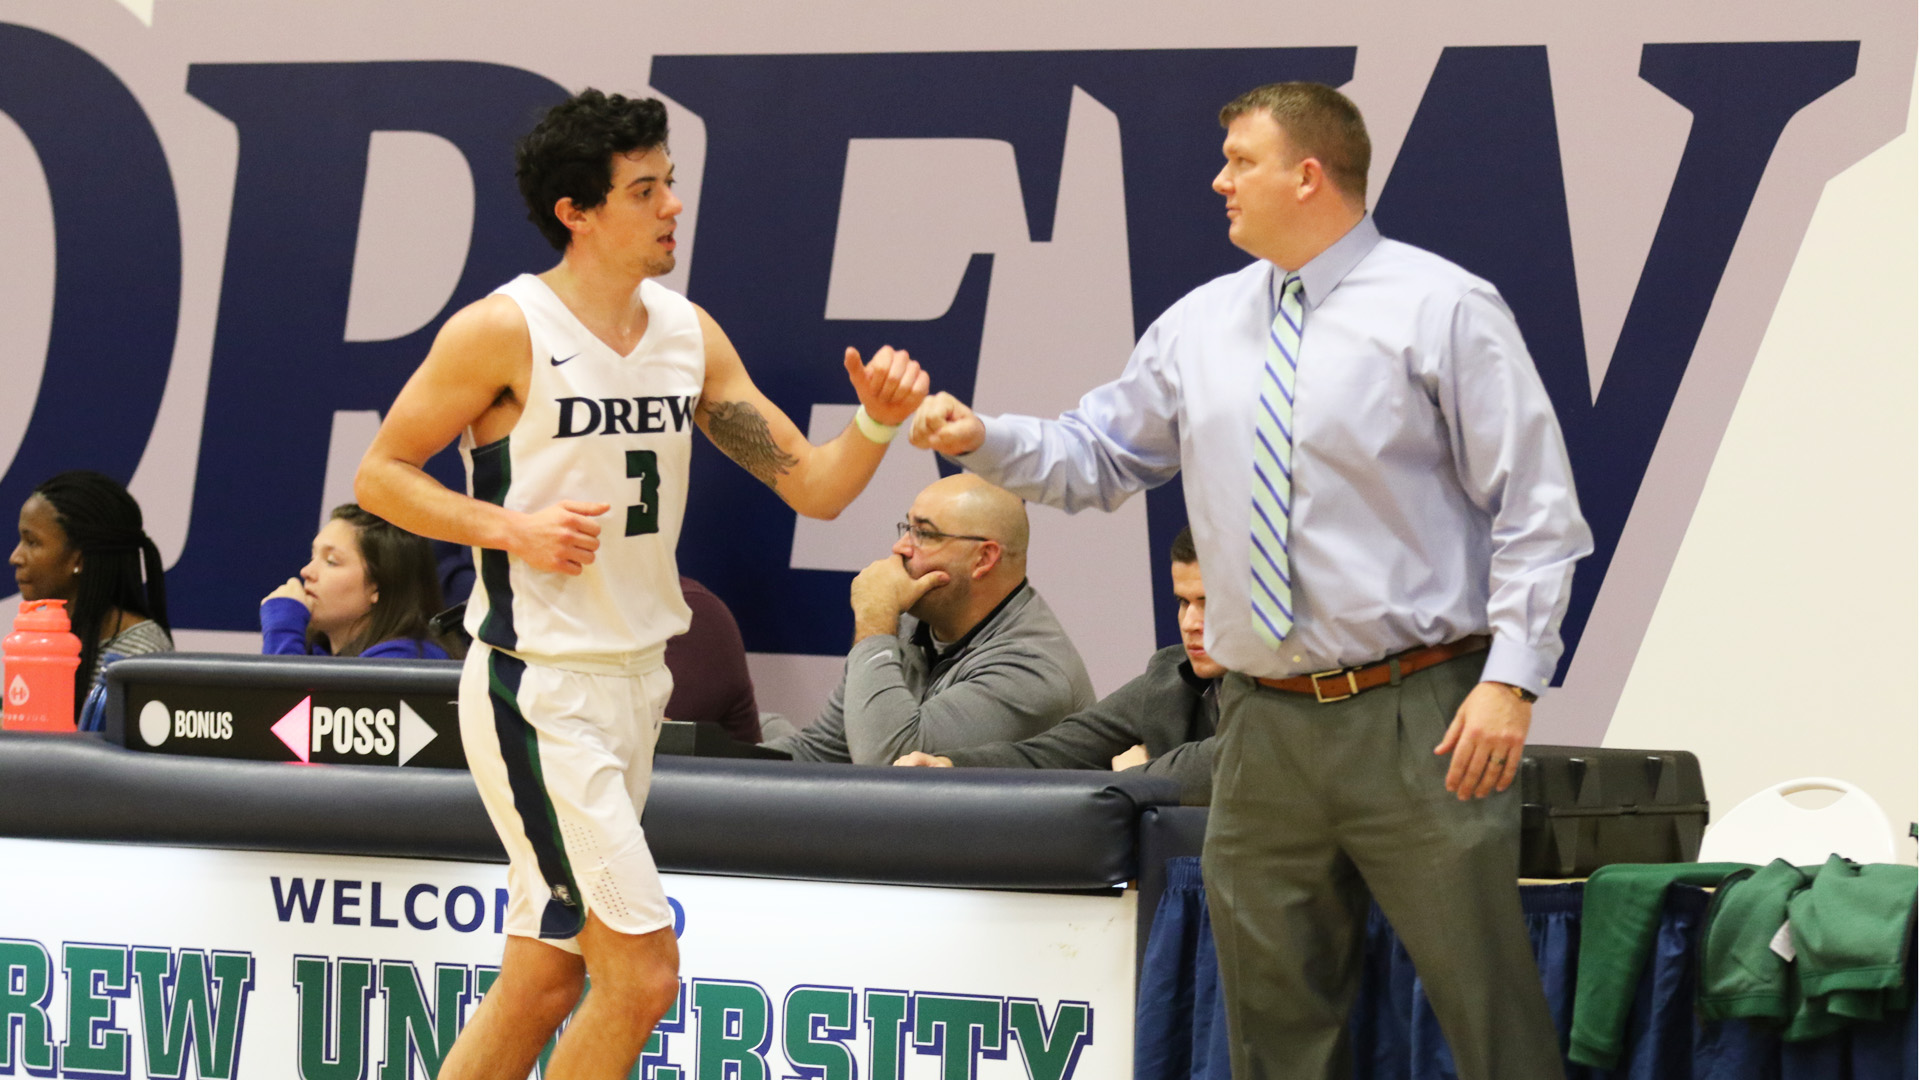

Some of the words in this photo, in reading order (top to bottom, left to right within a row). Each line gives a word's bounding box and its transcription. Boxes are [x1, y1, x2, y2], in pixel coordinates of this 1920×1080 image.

[552, 395, 697, 438] DREW
[625, 450, 661, 537] 3
[174, 710, 233, 739] BONUS
[312, 706, 396, 755] POSS
[270, 876, 508, 933] WELCO
[293, 954, 1093, 1080] UNRSITY
